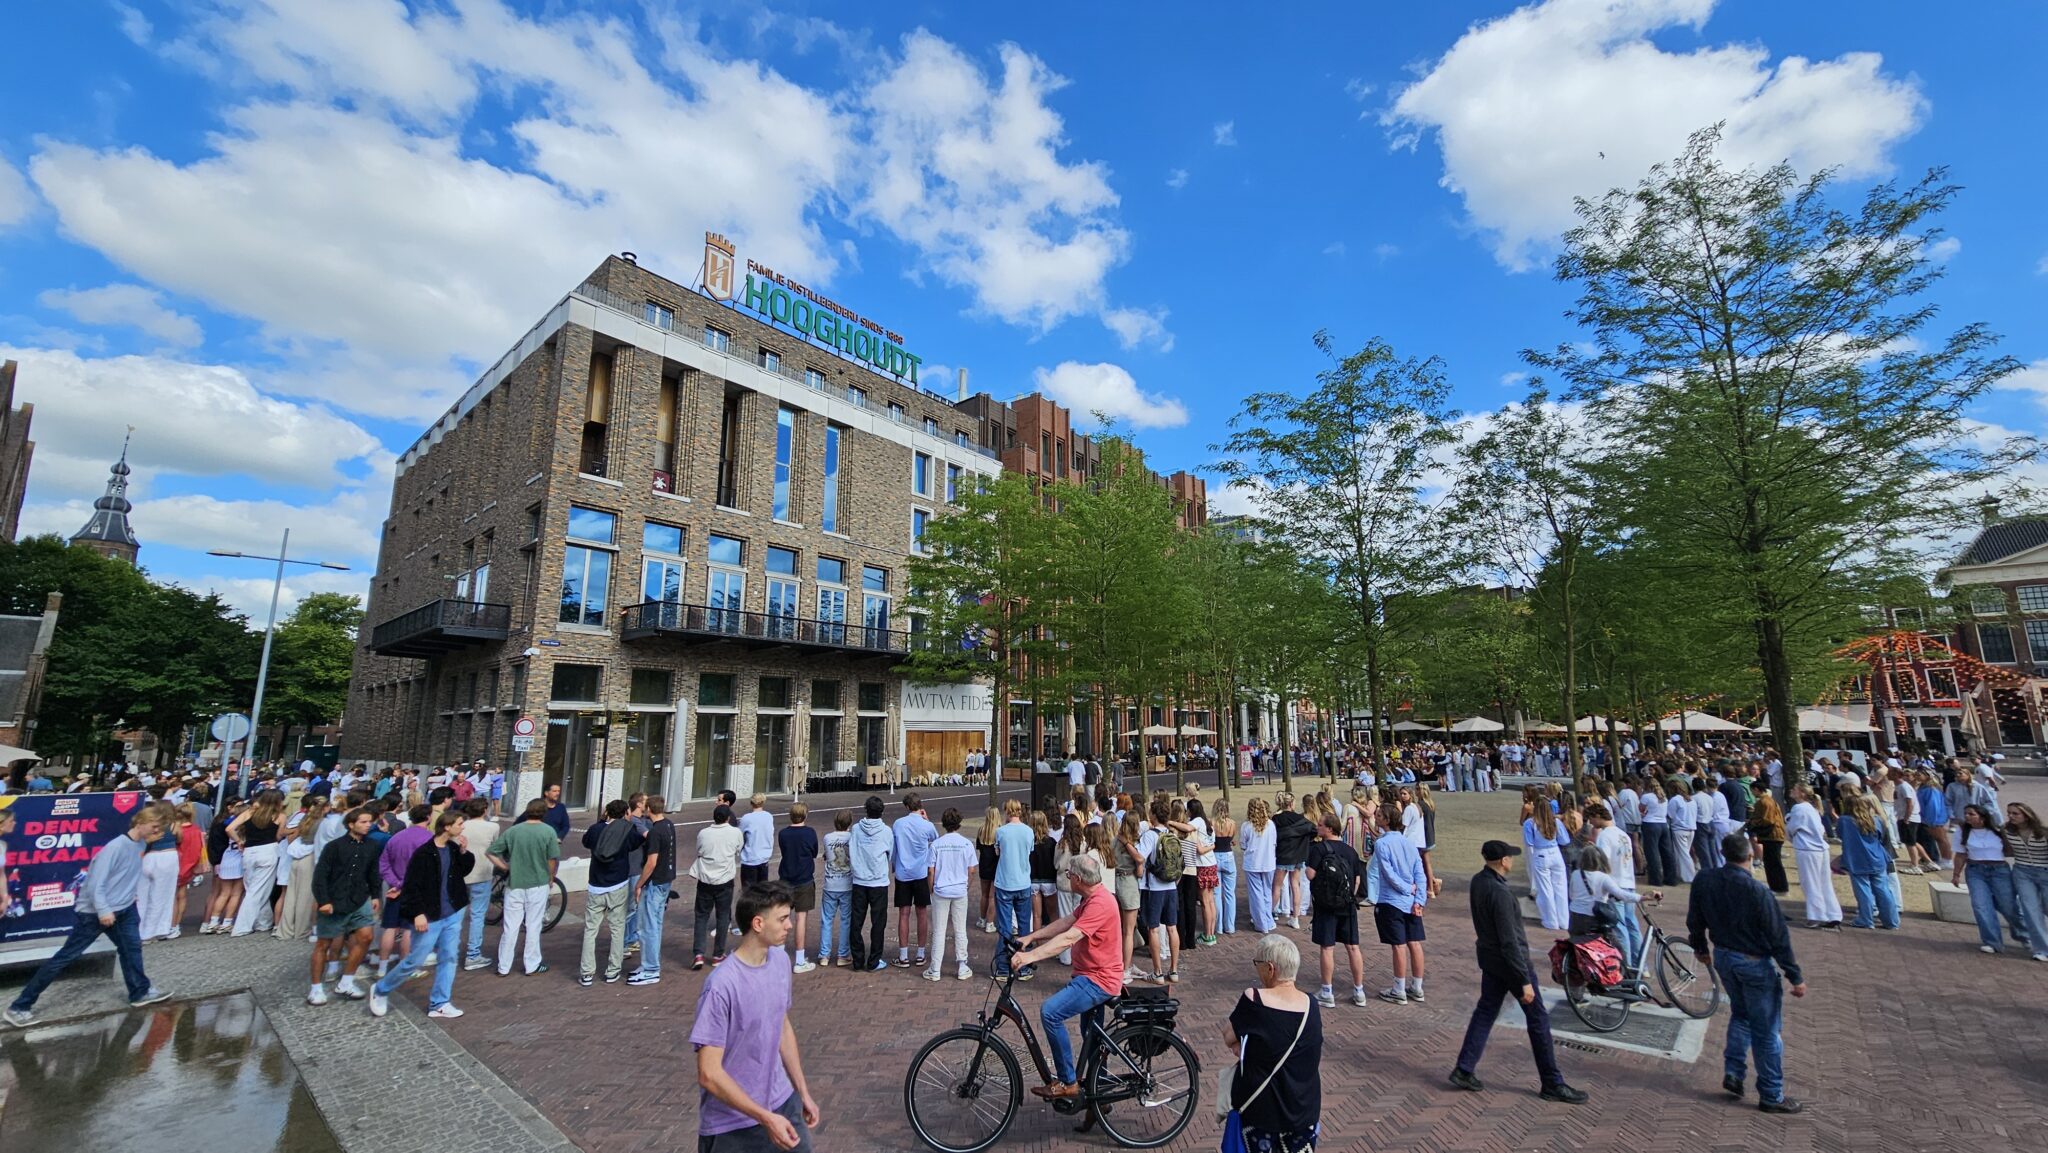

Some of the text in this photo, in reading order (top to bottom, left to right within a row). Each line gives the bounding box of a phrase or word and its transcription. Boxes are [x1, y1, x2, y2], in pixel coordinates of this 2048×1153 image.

[747, 258, 785, 286] FAMILIE
[860, 317, 884, 336] SINDS
[745, 273, 923, 384] HOOGHOUDT
[903, 692, 956, 711] MVTVA
[24, 818, 98, 835] DENK
[35, 833, 82, 850] OM
